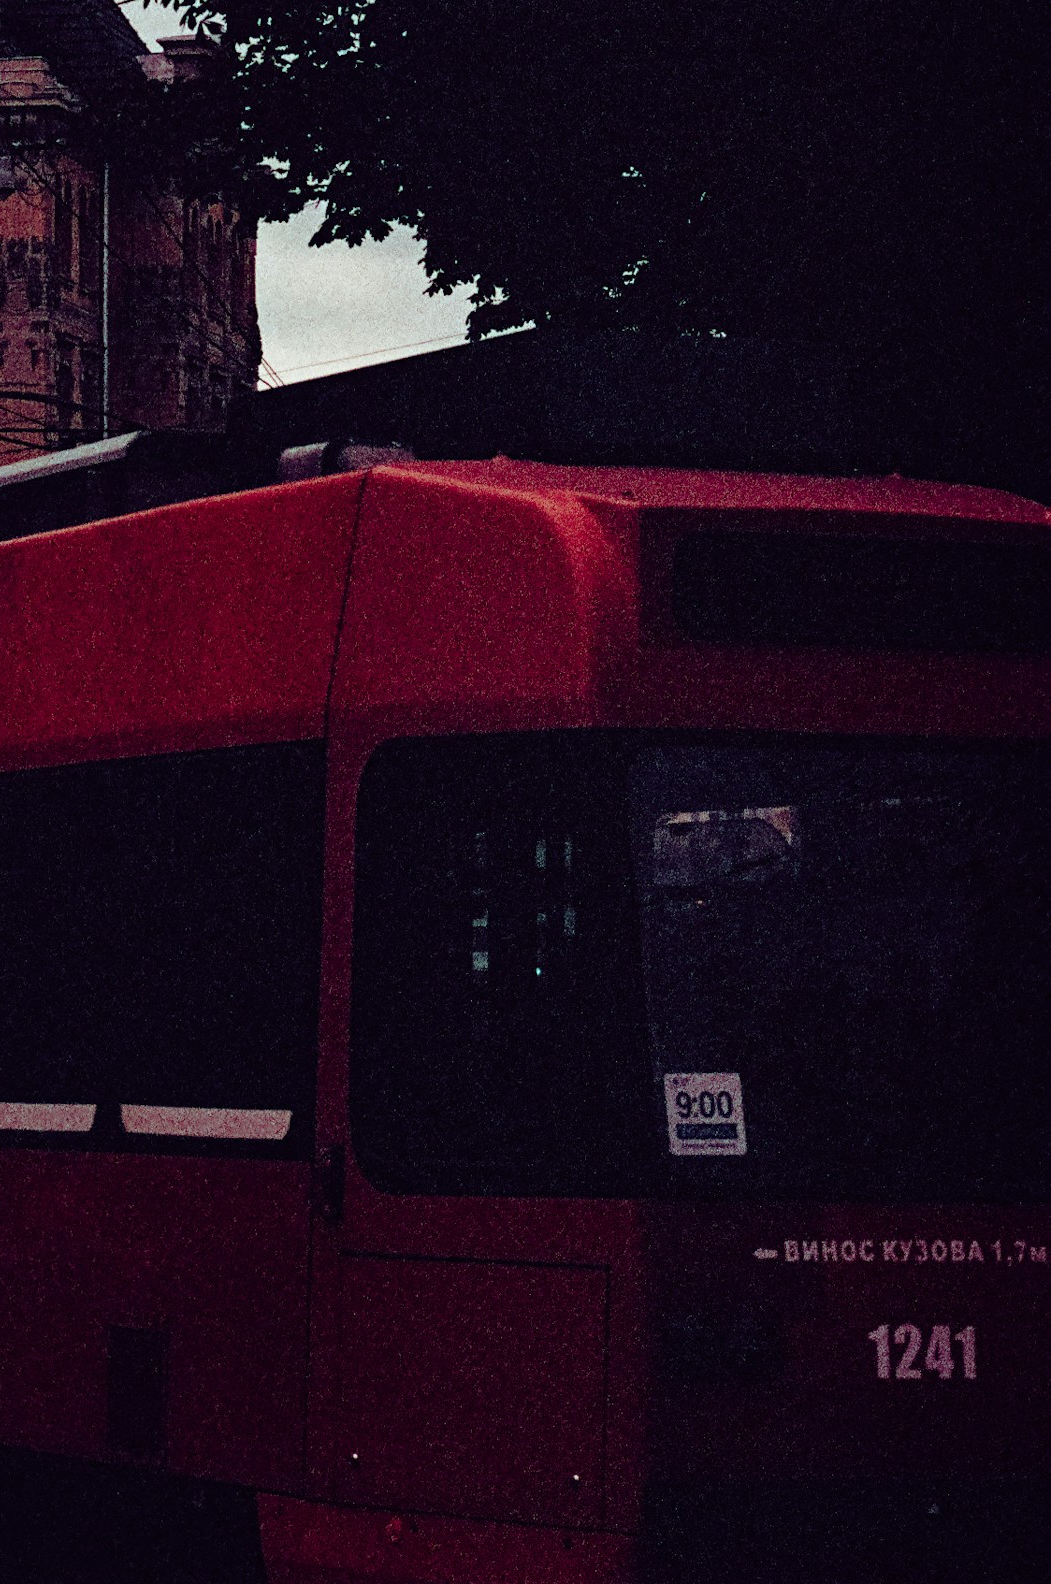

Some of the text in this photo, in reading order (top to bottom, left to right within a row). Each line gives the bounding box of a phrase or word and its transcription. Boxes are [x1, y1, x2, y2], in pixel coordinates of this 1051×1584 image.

[675, 1090, 732, 1118] 9:00
[783, 1239, 874, 1262] ВИНОС
[882, 1239, 984, 1262] КУЗОВА
[867, 1323, 978, 1380] 1241
